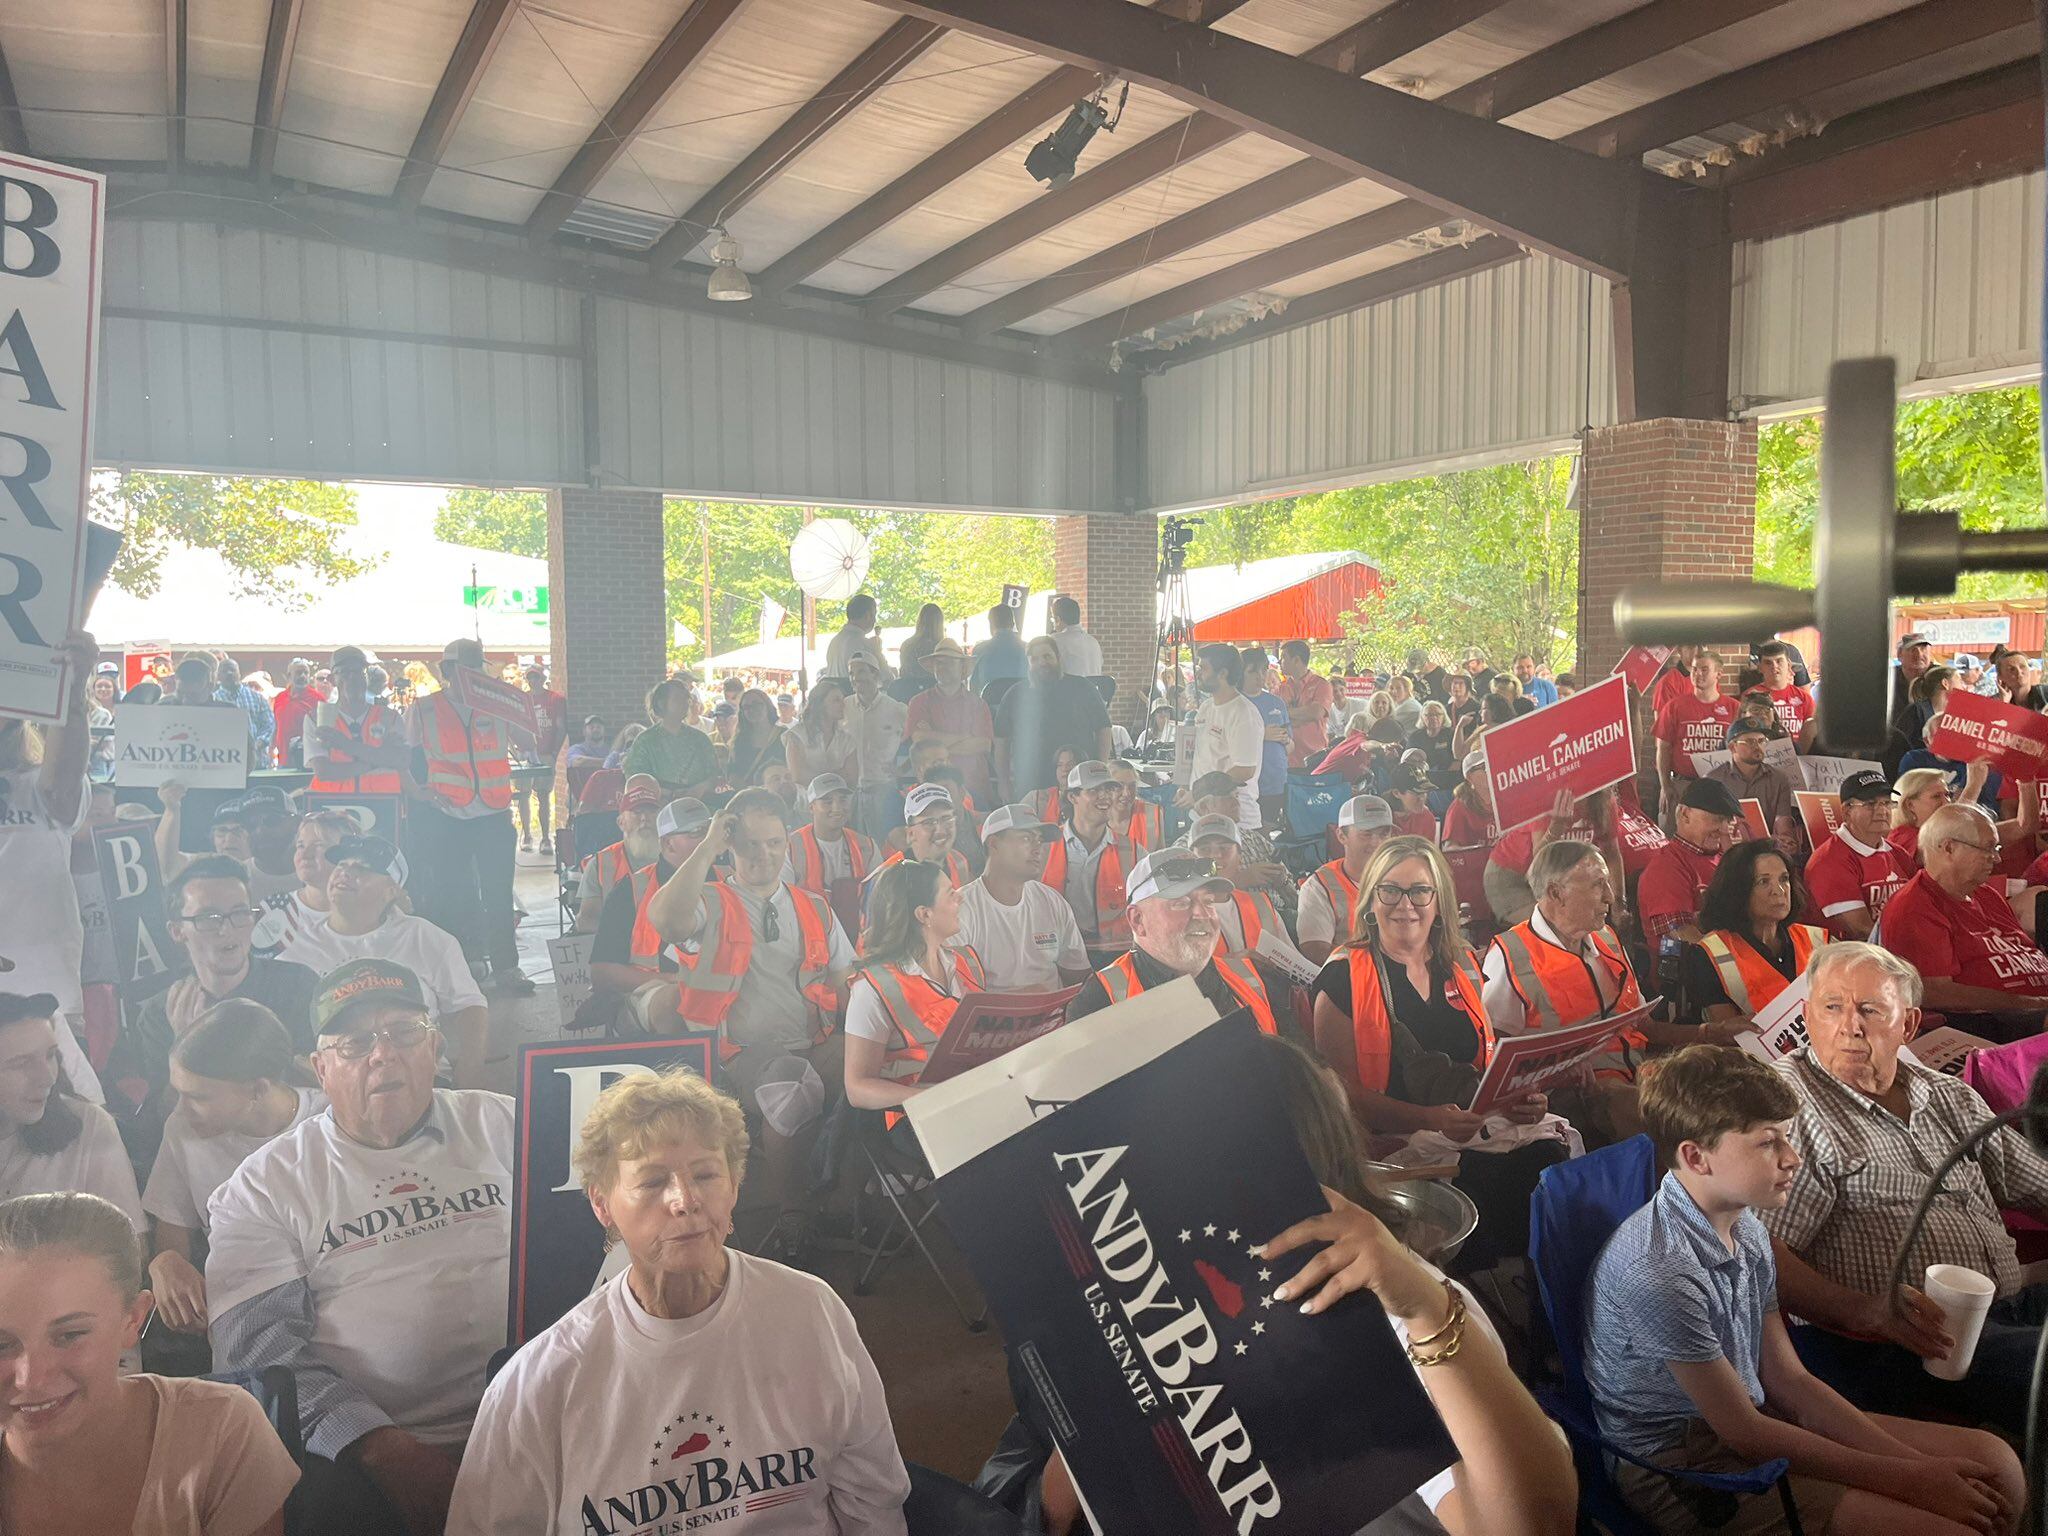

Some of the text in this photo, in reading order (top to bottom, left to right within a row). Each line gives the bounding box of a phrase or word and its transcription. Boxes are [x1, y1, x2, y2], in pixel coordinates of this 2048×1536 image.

[1687, 723, 1725, 739] DANIEL
[1940, 713, 1985, 740] DANIEL
[1496, 719, 1625, 791] DANIEL CAMERON
[383, 1218, 450, 1244] U.S. SENATE
[1083, 1281, 1159, 1414] U.S. SENATE
[658, 1504, 741, 1536] U.S. SENATE
